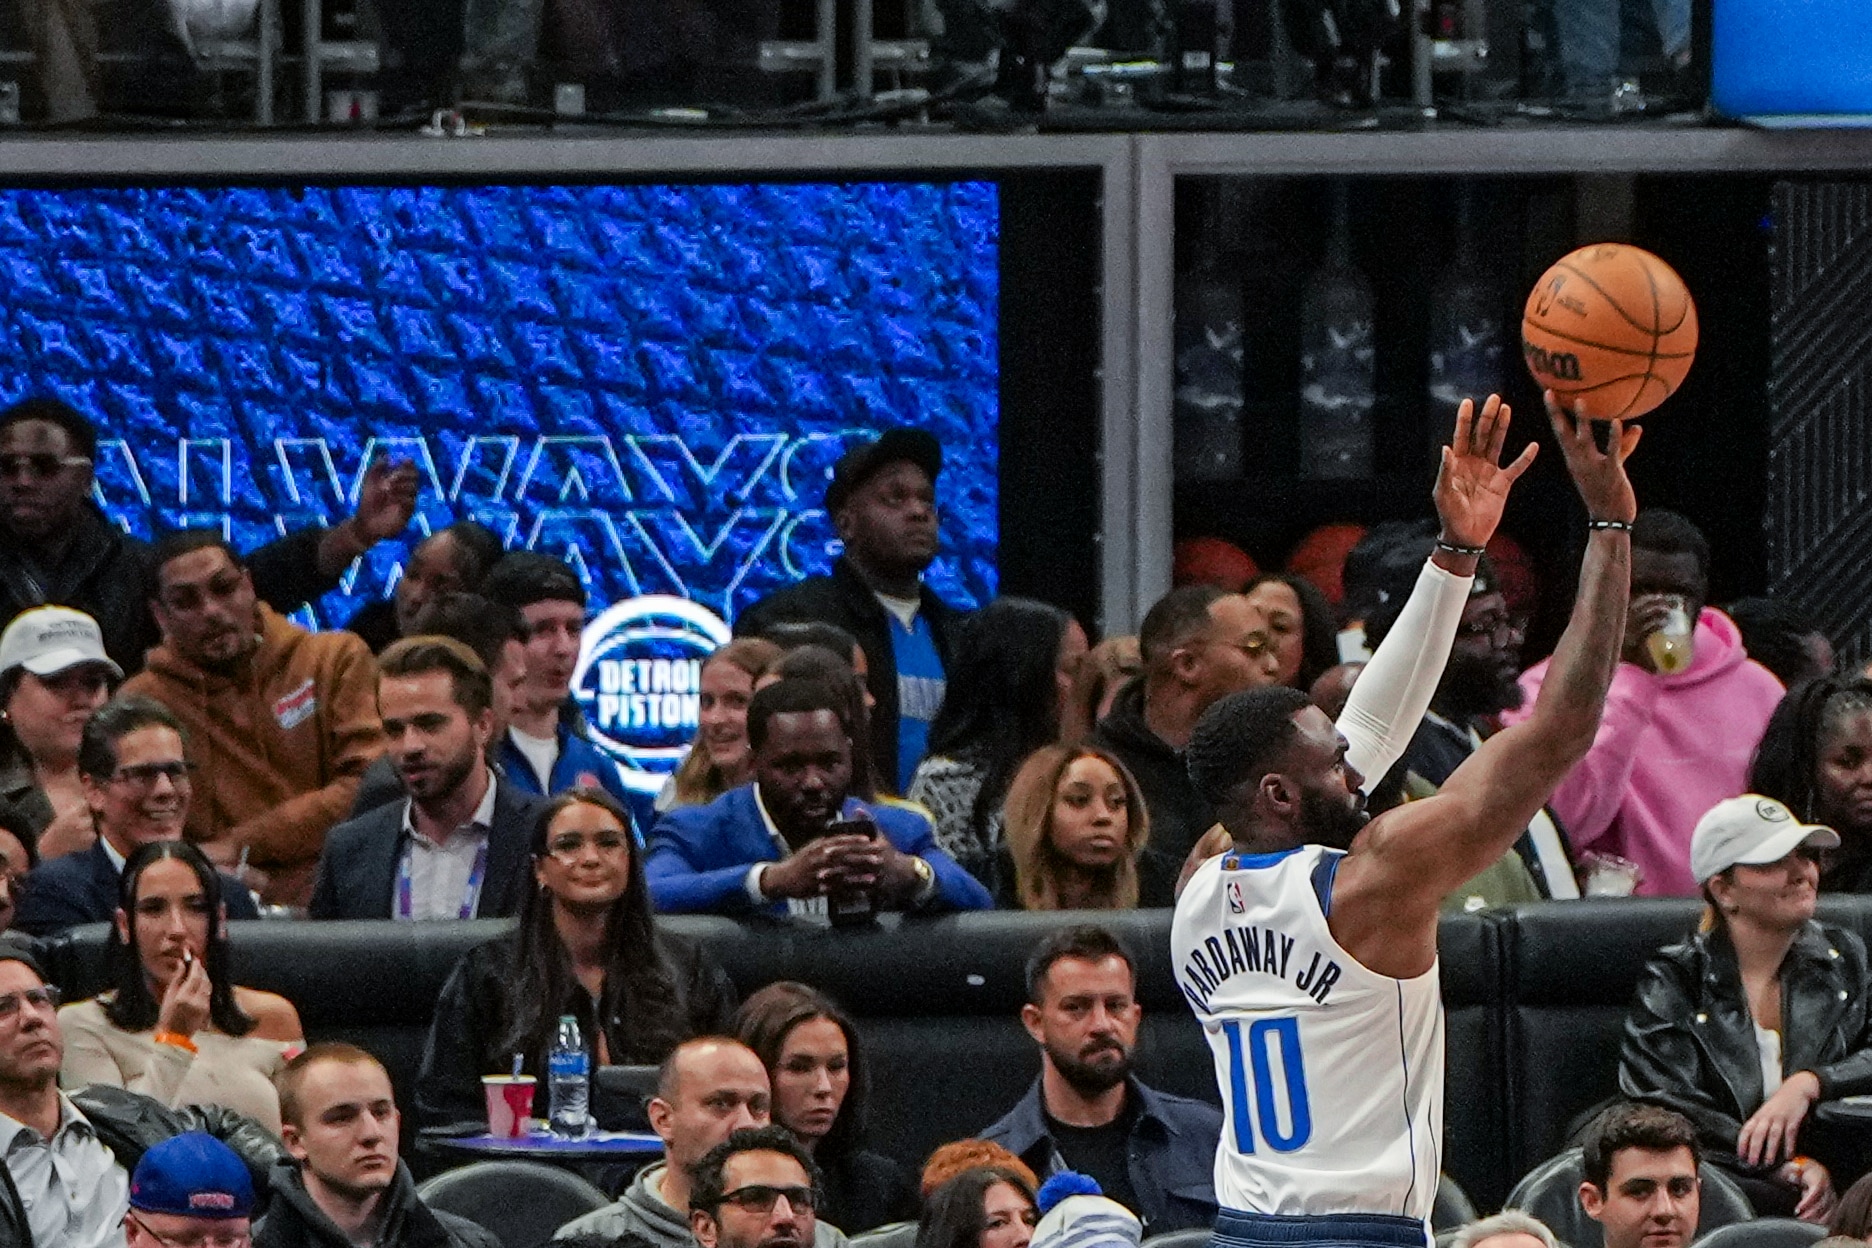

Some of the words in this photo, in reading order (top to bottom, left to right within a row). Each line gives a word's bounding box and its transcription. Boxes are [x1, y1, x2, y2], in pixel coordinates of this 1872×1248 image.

[598, 658, 700, 693] DETROI
[597, 693, 700, 728] PISTON
[1222, 1015, 1313, 1156] 10
